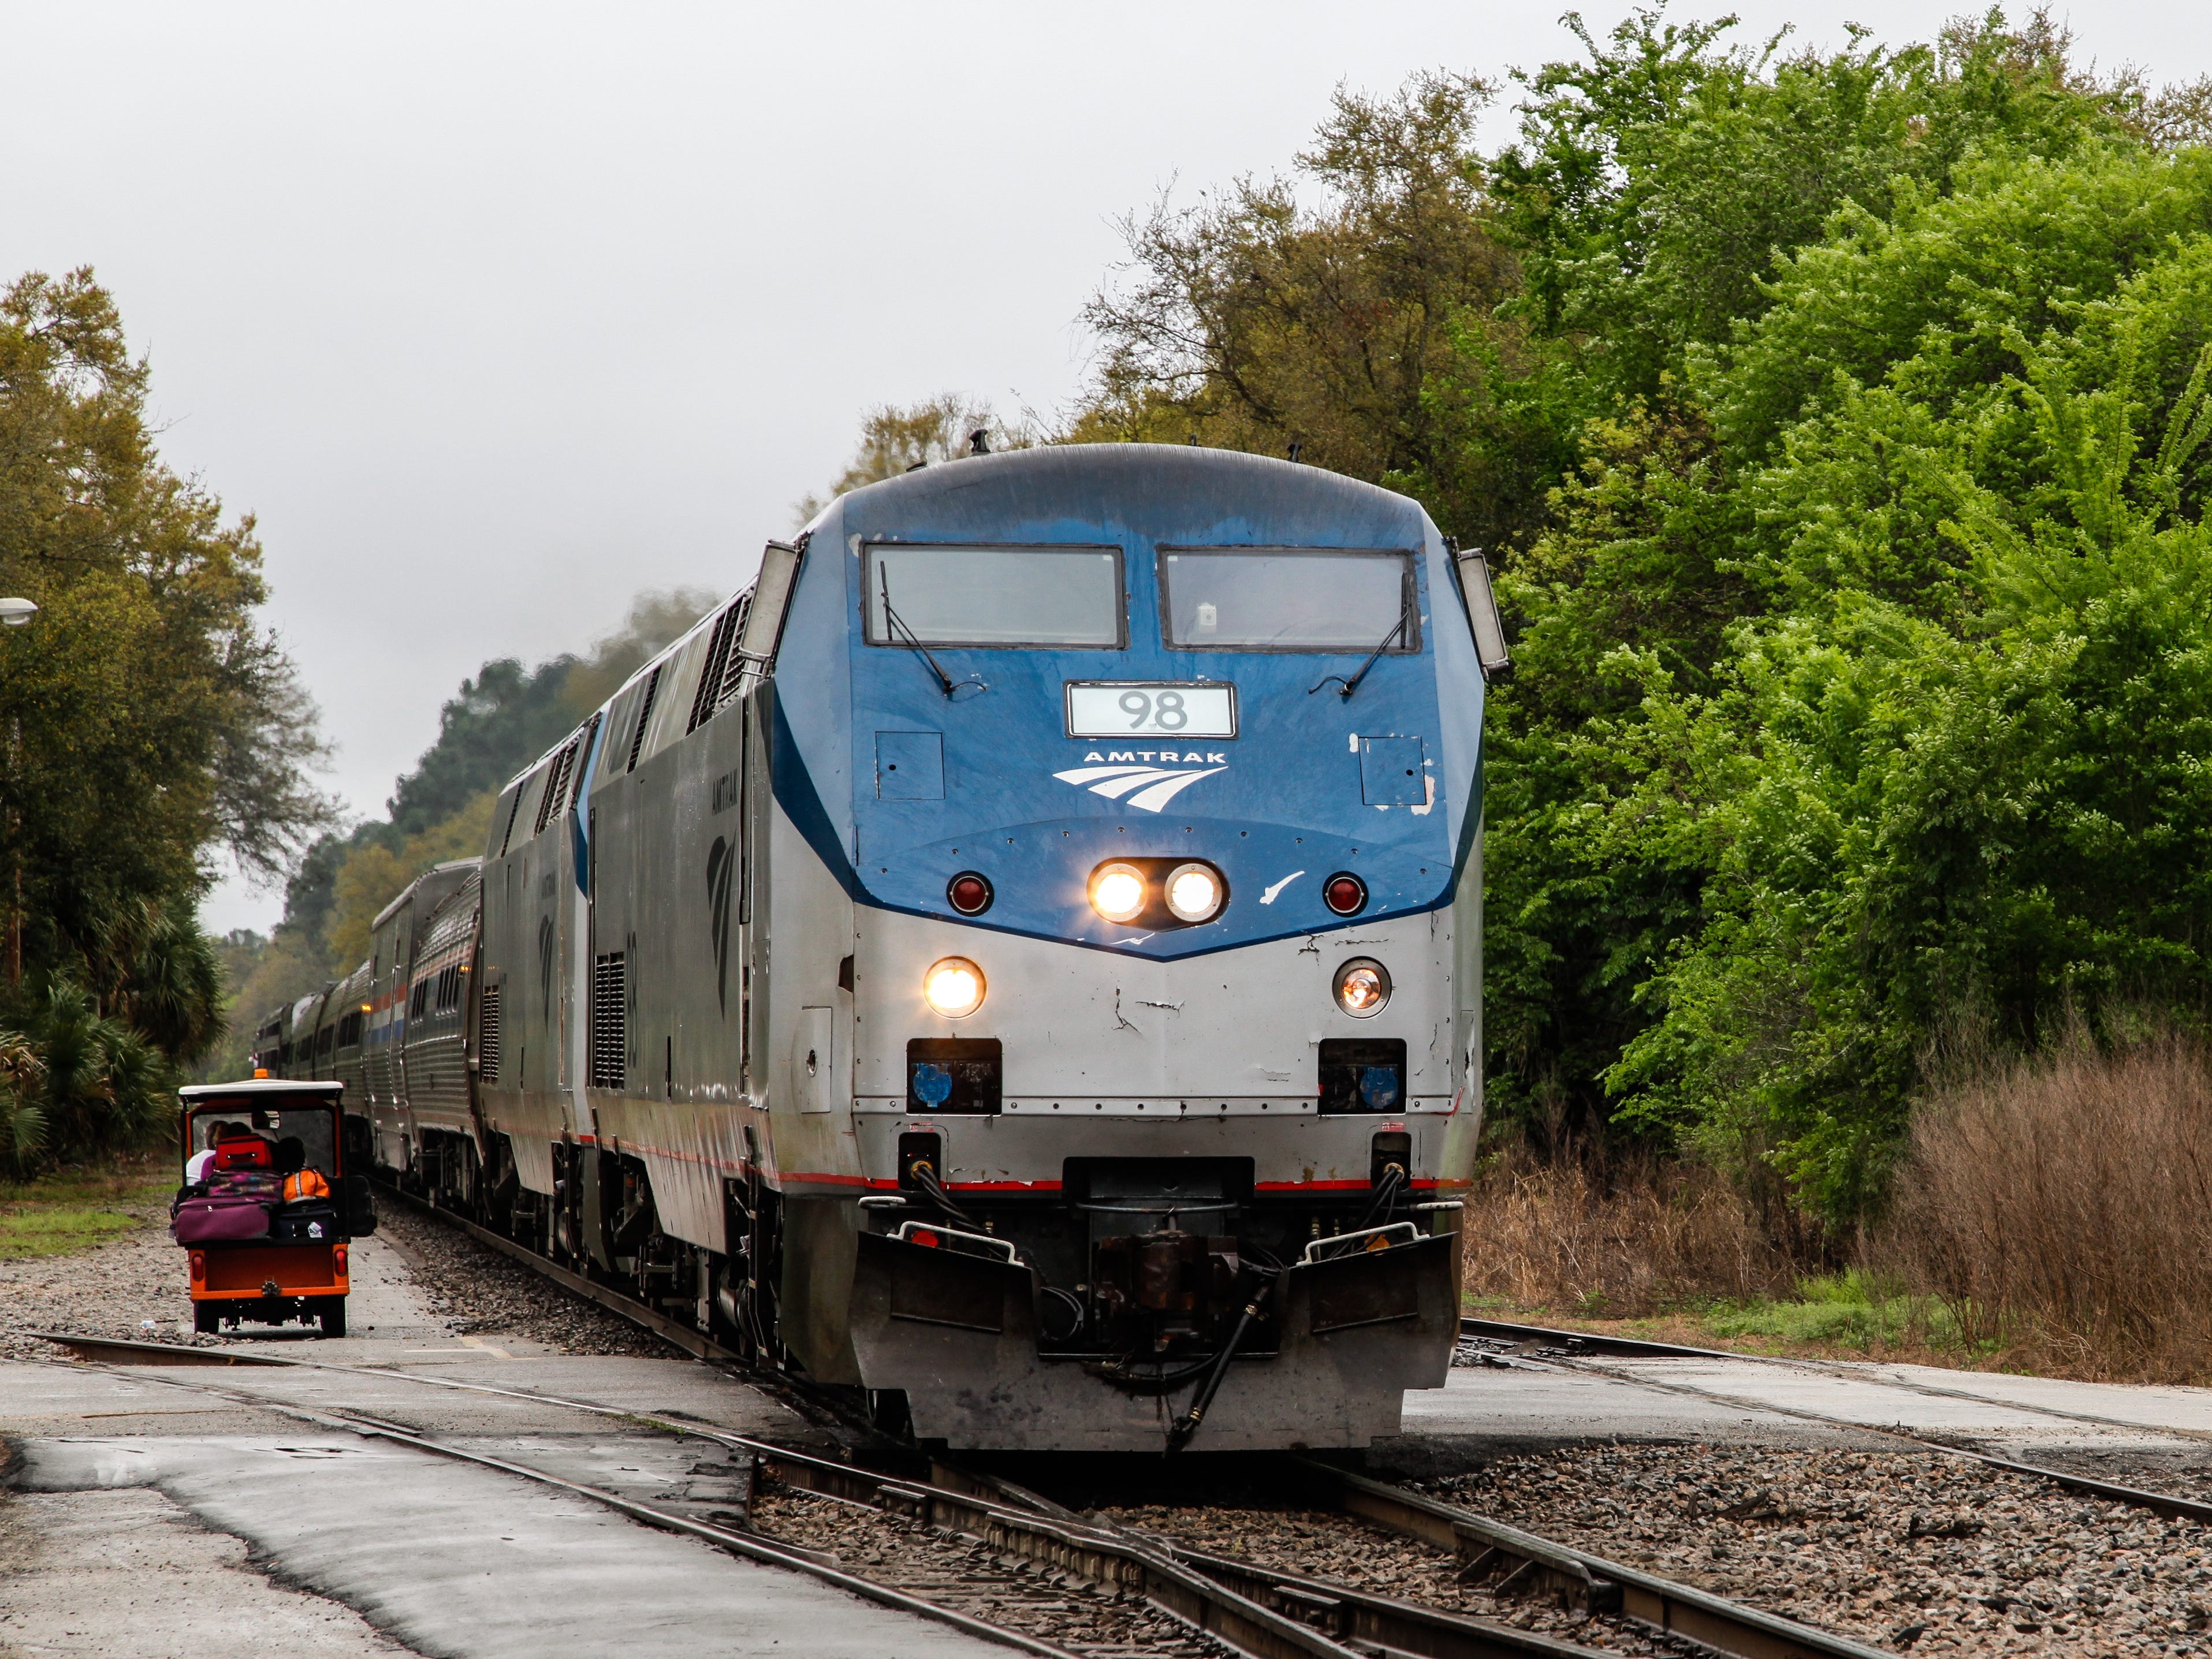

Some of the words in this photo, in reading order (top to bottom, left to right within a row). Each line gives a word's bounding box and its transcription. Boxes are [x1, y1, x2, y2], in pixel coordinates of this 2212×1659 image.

[1118, 691, 1187, 730] 98
[1083, 751, 1227, 763] AMTRAK
[712, 767, 738, 817] AMTRAK
